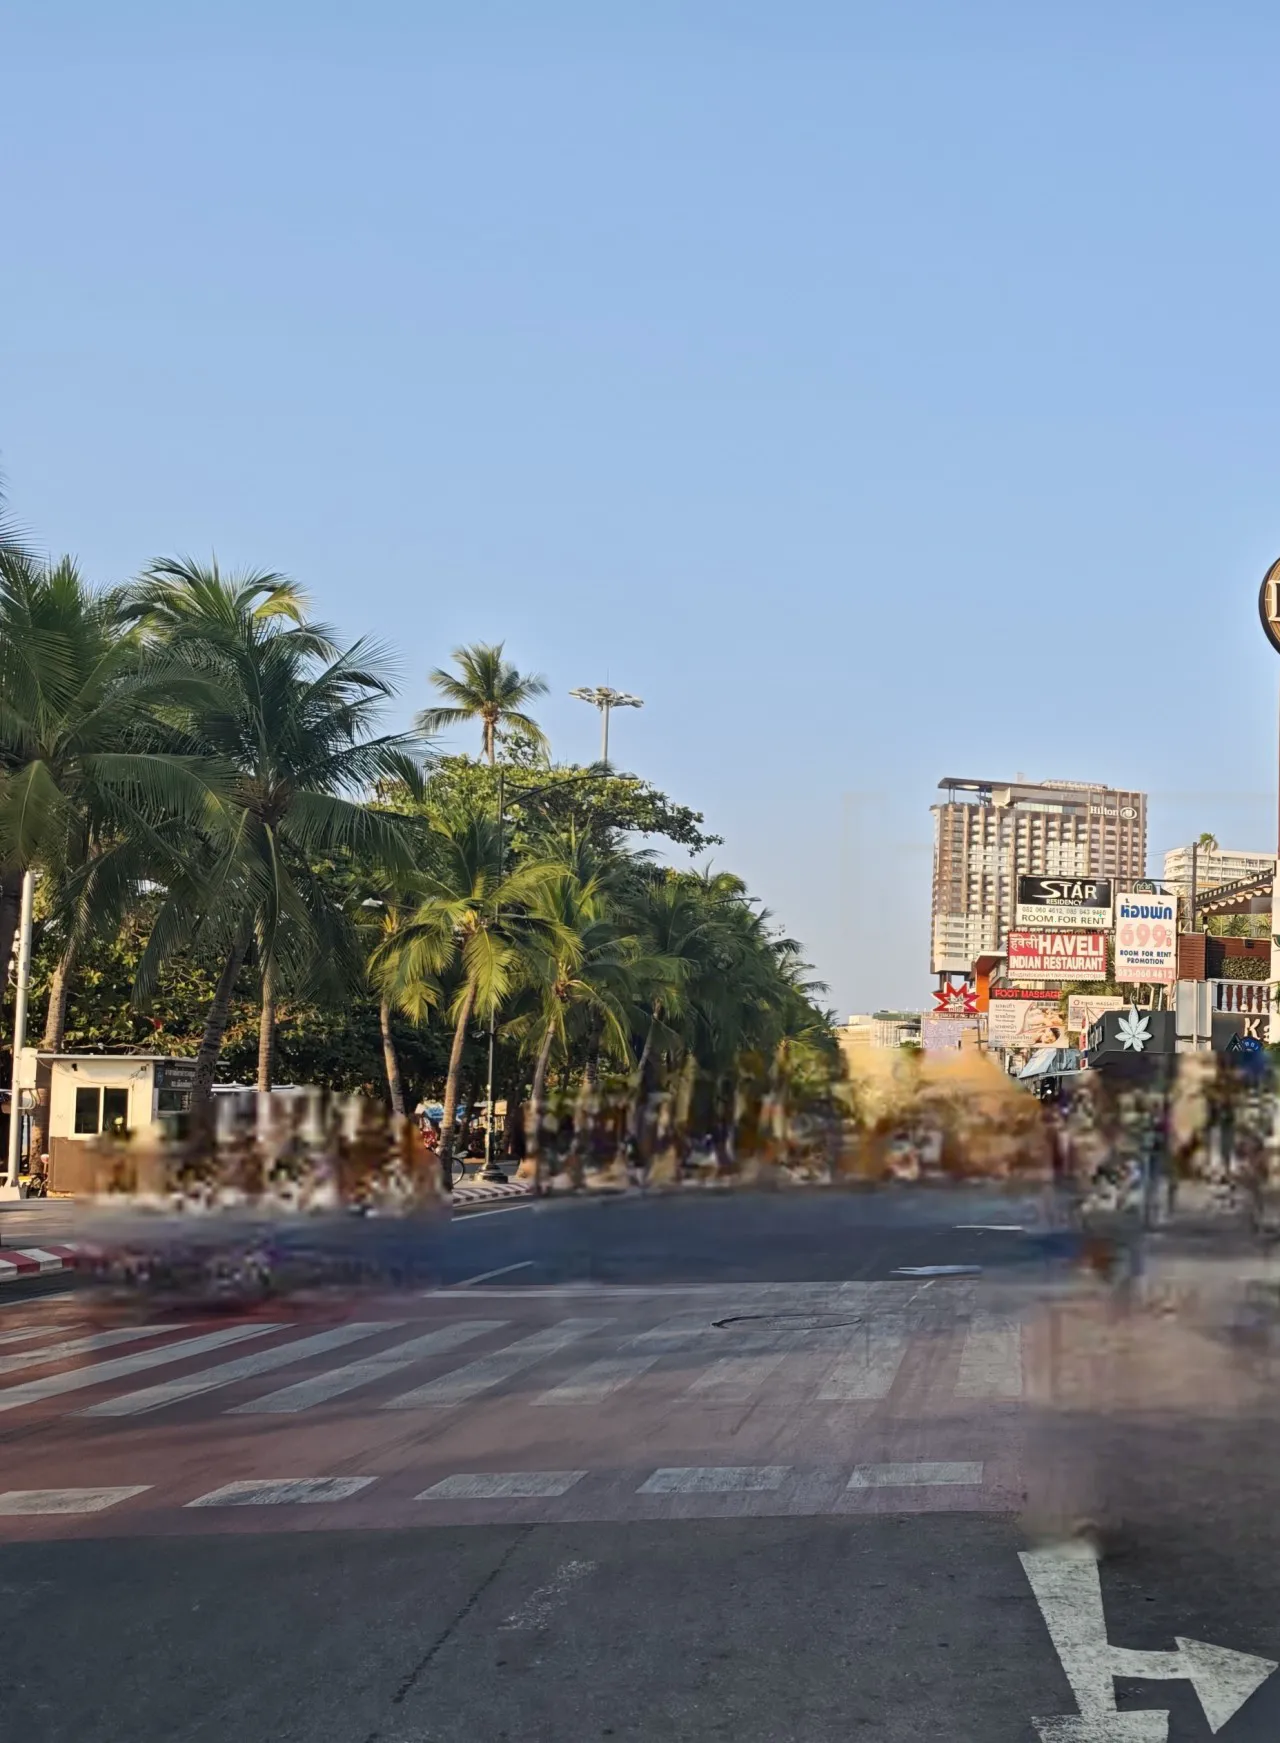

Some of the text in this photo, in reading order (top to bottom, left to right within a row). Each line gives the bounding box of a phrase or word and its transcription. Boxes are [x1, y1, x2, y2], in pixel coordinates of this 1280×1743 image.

[1032, 881, 1098, 900] STAR
[1120, 898, 1173, 920] ห้องพัก
[1021, 914, 1105, 925] ROOM FOR RENT
[1038, 934, 1104, 956] HAVELI
[1009, 956, 1103, 970] INDIAN RESTAURANT
[994, 989, 1019, 997] FOOT
